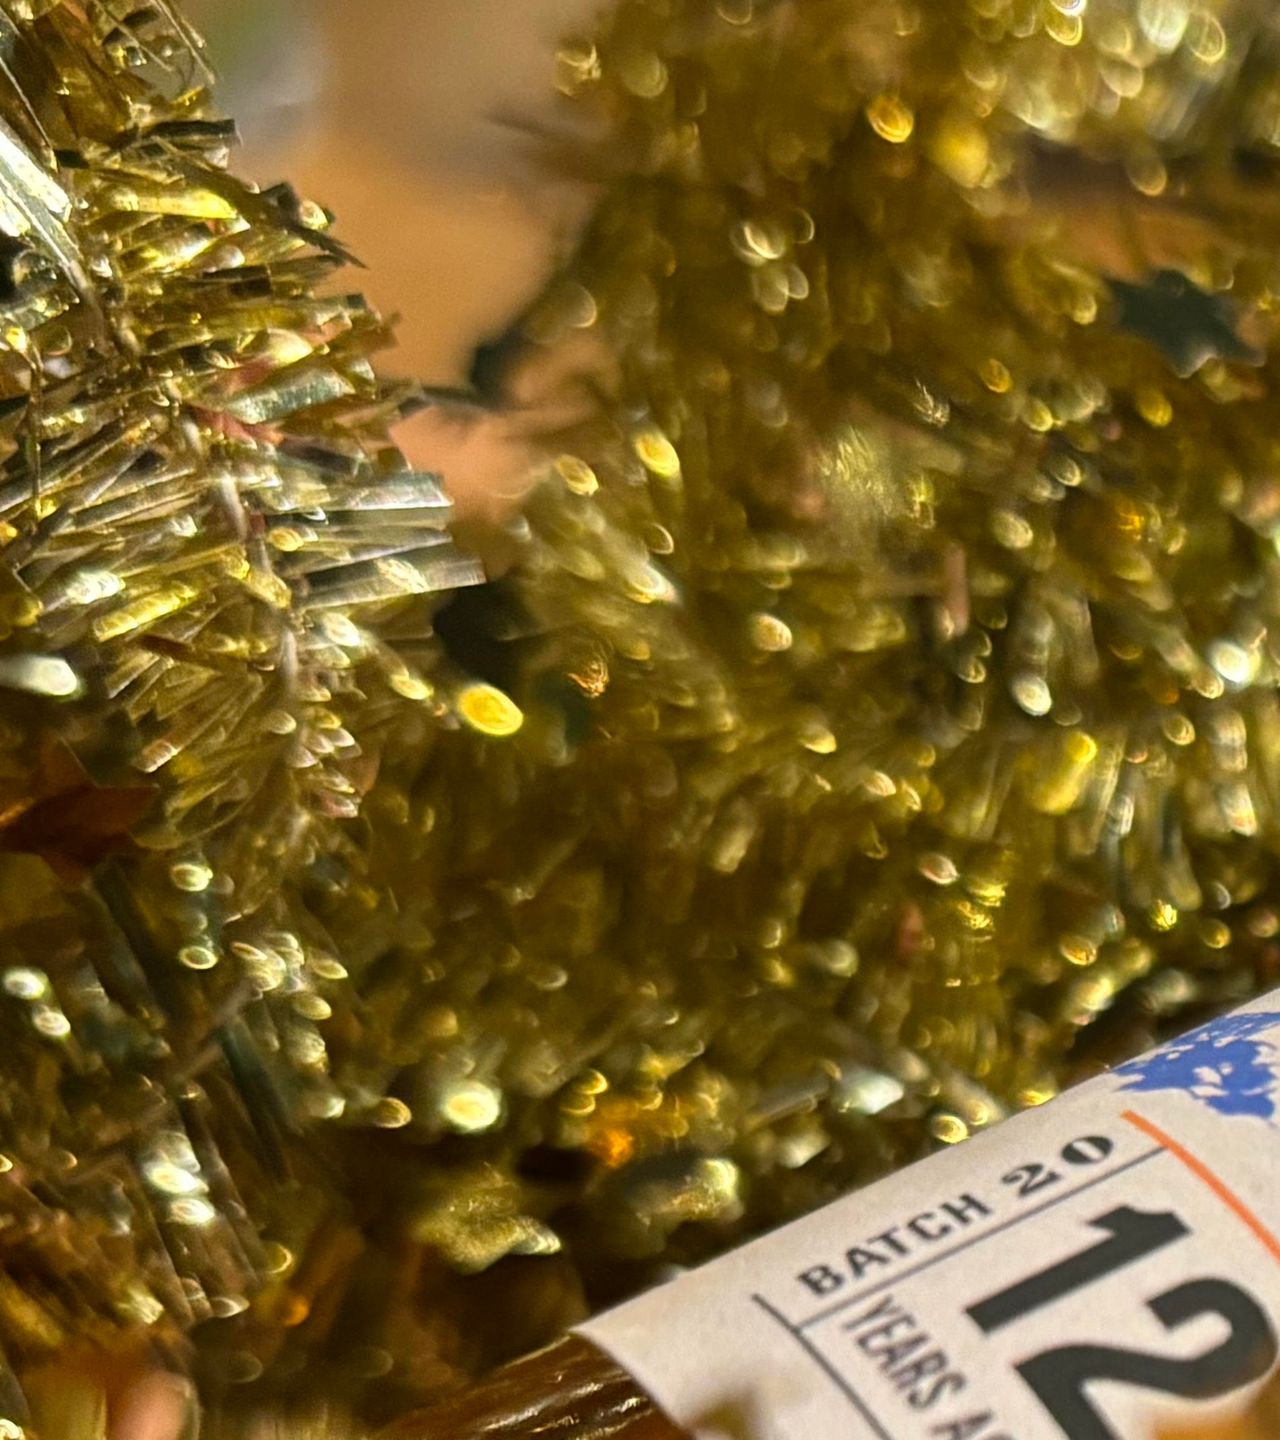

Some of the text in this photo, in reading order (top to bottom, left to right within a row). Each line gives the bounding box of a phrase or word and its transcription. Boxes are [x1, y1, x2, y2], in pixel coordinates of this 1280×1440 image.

[798, 1135, 1114, 1296] BATCH 20
[844, 1295, 966, 1409] YEARS
